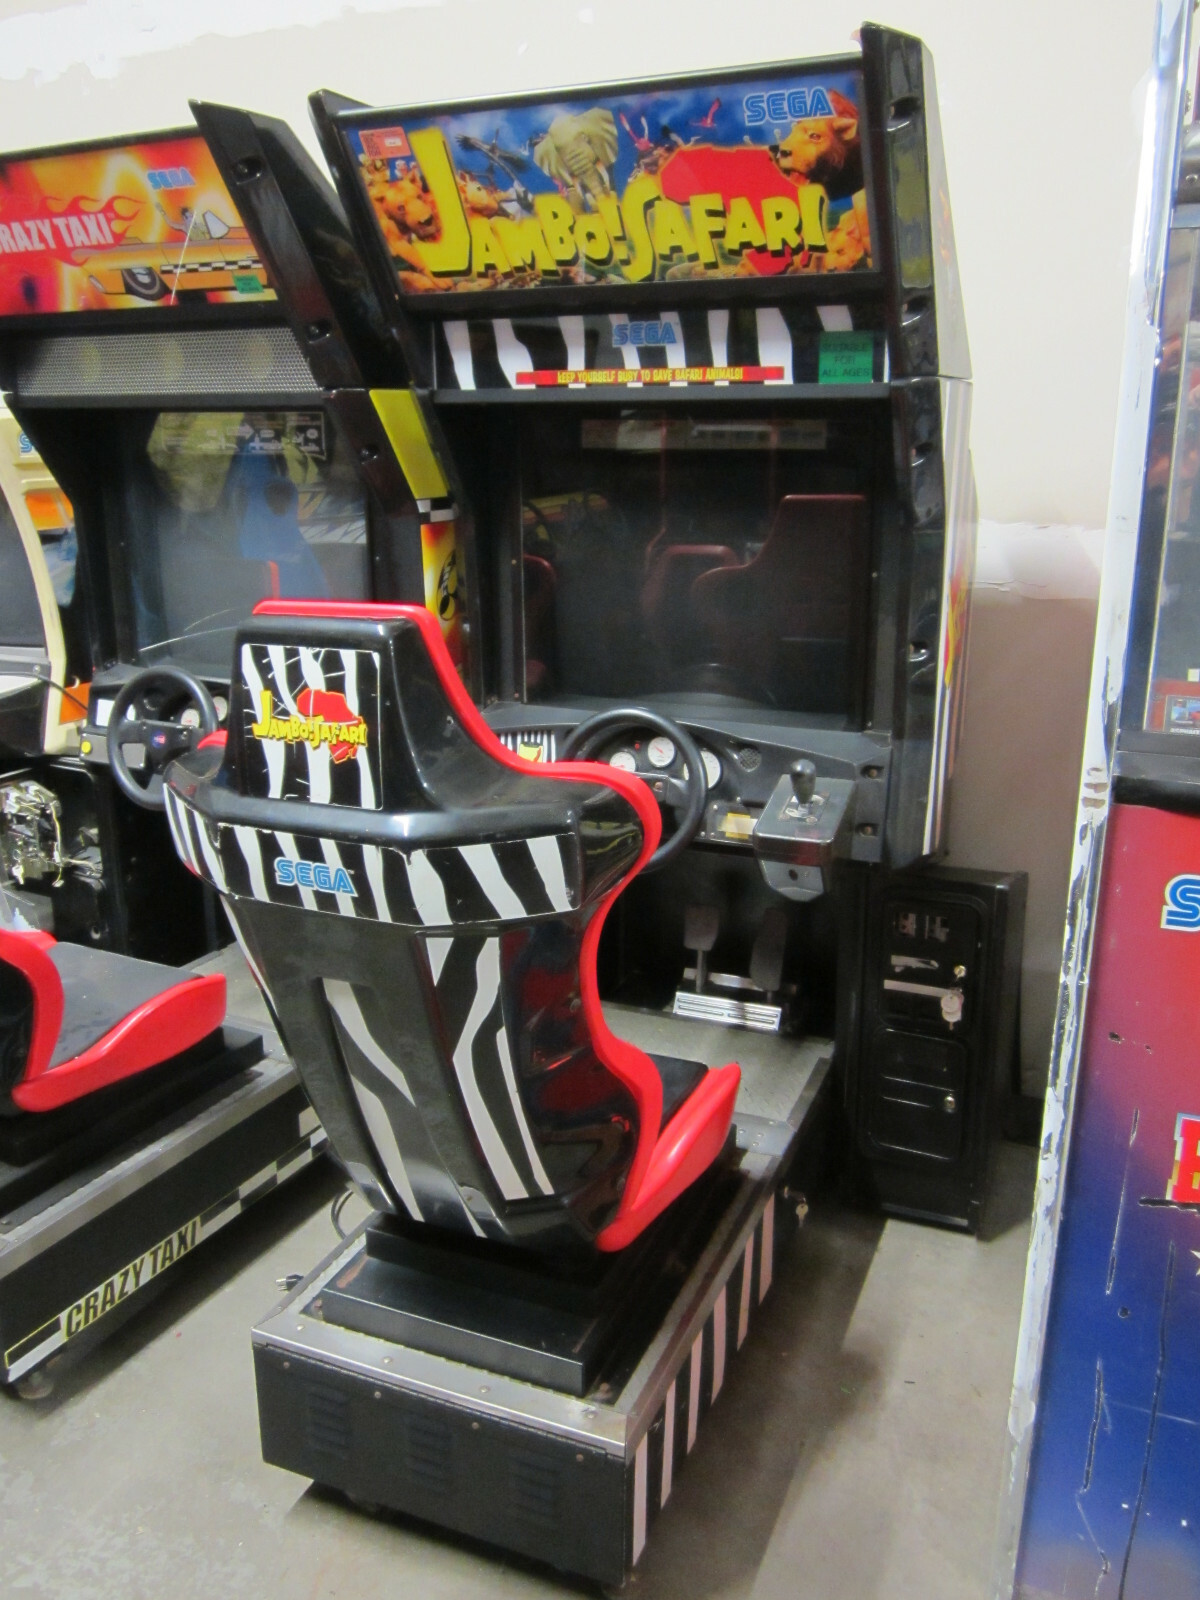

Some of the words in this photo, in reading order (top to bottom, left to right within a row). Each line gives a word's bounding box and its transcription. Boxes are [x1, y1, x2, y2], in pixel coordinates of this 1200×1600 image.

[743, 86, 835, 126] SEGA
[146, 166, 196, 190] SEGA
[0, 218, 57, 254] RAZY
[52, 212, 115, 249] TAXI
[621, 174, 829, 283] SAFARI
[612, 320, 678, 347] SEGA
[640, 367, 652, 382] TO
[674, 366, 703, 381] SAFARI
[821, 368, 838, 377] ALL
[842, 367, 871, 377] AGES
[834, 355, 856, 365] FOR
[310, 715, 368, 750] SAFARI
[274, 856, 357, 897] SEGA
[66, 1257, 145, 1338] CRAZY
[149, 1219, 197, 1276] TAXI
